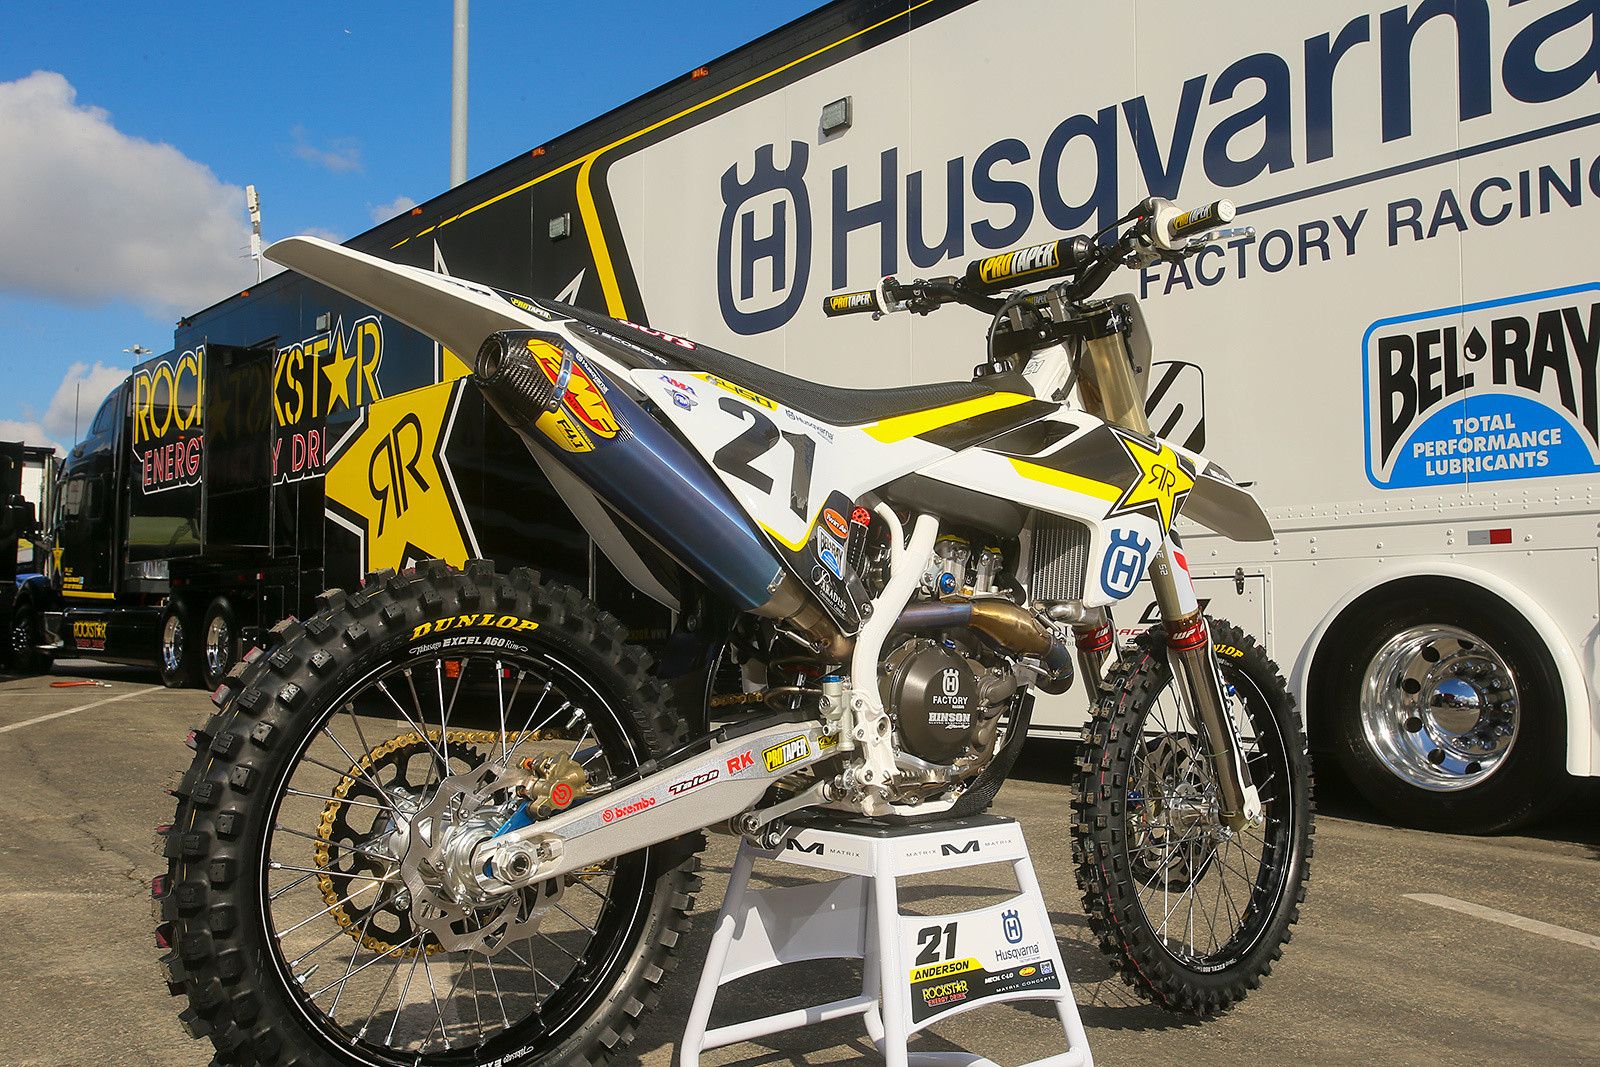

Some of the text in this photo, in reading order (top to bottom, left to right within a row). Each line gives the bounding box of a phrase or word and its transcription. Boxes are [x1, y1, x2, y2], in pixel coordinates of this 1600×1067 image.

[831, 0, 1600, 291] Husqvarna
[1174, 204, 1213, 230] PROTAPER
[982, 244, 1057, 280] PROTAPER
[1140, 209, 1369, 299] FACTORY
[512, 298, 550, 319] PROTAPER
[832, 292, 872, 311] PROTAPER
[658, 373, 698, 397] AMA
[556, 419, 587, 449] F4.1
[1452, 413, 1516, 435] TOTAL
[1413, 428, 1562, 458] PERFORMANCE
[712, 396, 816, 524] 21
[1425, 450, 1549, 476] LUBRICANTS
[409, 613, 540, 642] DUNLOP
[442, 636, 482, 648] EXCEL
[482, 636, 505, 647] A60
[1213, 643, 1245, 659] NLOP
[932, 695, 969, 705] FACTORY
[928, 712, 971, 722] HINSON
[726, 750, 755, 775] RK
[766, 738, 808, 769] PROTAPER
[670, 771, 719, 793] Talon
[614, 797, 656, 819] brembo
[829, 848, 861, 858] MATRIX
[905, 849, 937, 857] MATRIX
[984, 839, 1013, 847] MATRIX
[915, 921, 958, 966] 21
[995, 943, 1040, 962] Husqvarna
[914, 960, 969, 980] ANDERSON
[922, 980, 969, 1000] ROCKSTAR
[996, 975, 1056, 993] MATRIX CONCEPTS
